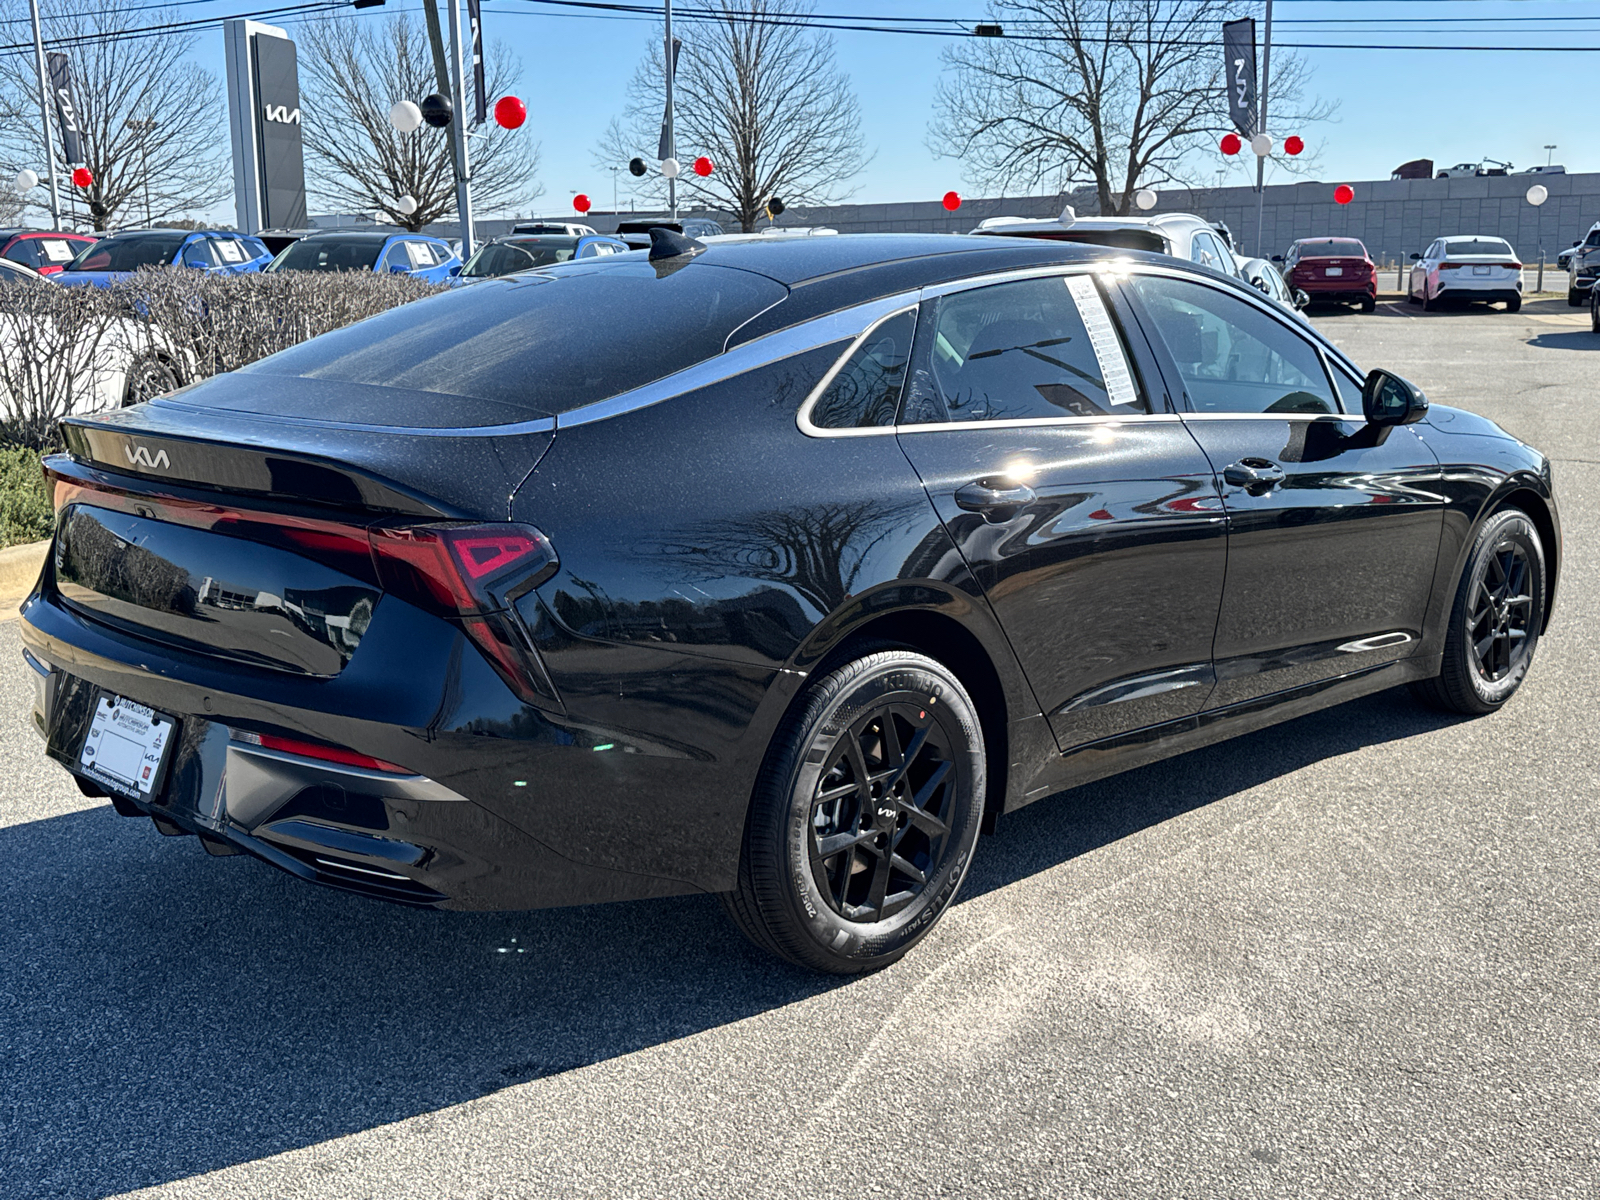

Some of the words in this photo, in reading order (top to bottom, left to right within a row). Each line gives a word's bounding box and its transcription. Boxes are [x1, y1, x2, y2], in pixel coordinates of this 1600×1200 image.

[58, 88, 77, 132] KIA
[265, 103, 300, 125] KIA
[125, 444, 171, 470] KIA
[144, 753, 160, 764] KIA
[877, 807, 896, 818] KIA
